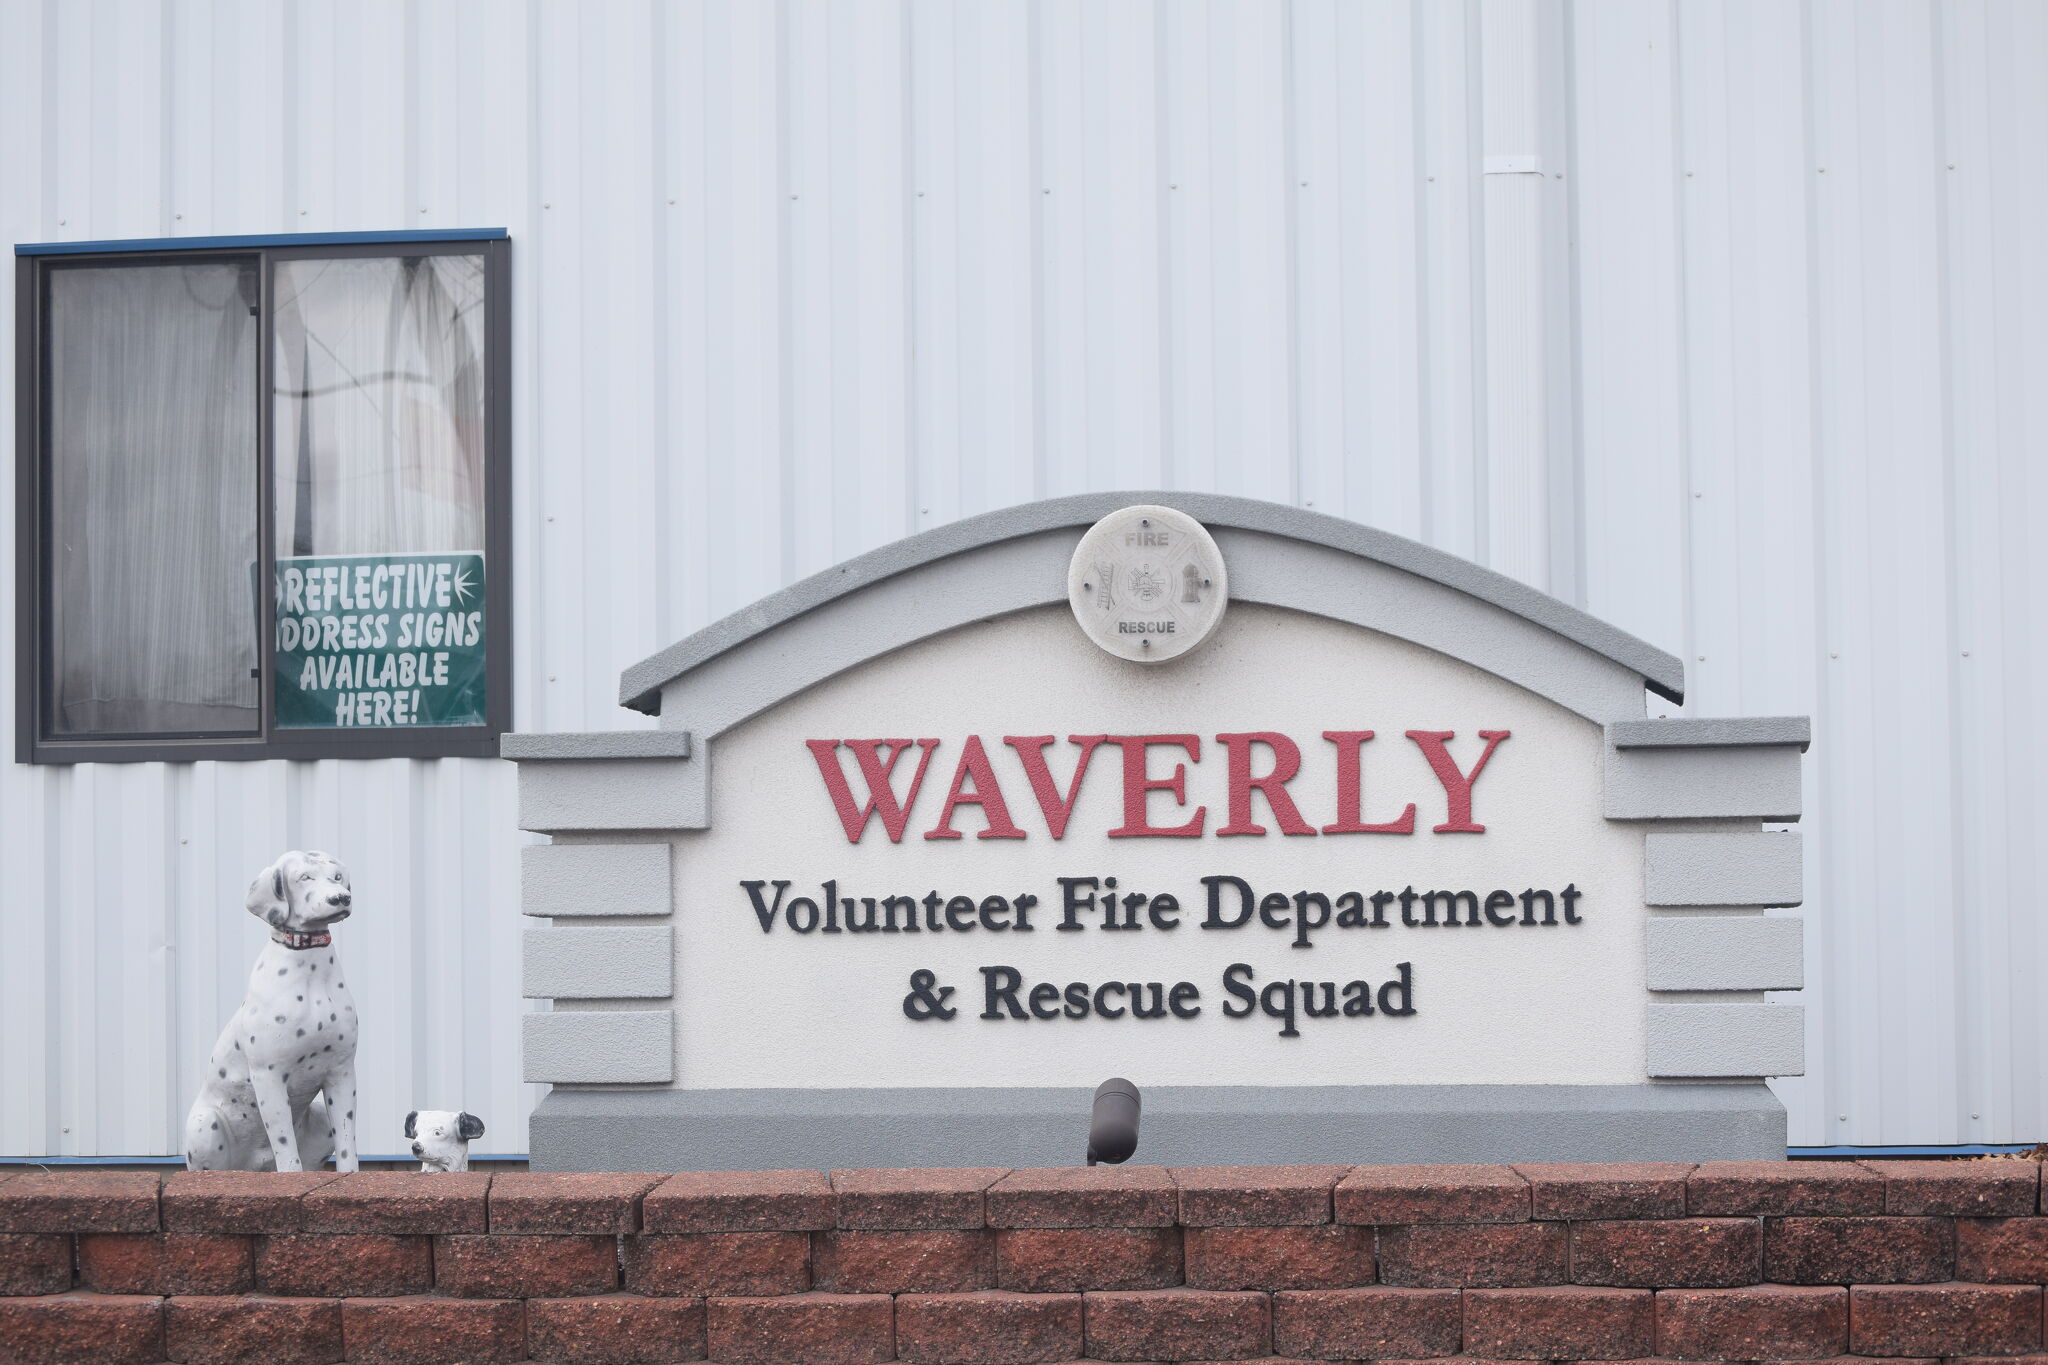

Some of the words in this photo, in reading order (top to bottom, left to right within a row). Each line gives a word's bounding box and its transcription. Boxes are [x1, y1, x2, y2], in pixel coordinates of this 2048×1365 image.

[1125, 532, 1169, 547] FIRE
[284, 563, 451, 615] REFLECTIVE
[276, 614, 390, 652] DDRESS
[397, 611, 482, 648] SIGNS
[1118, 621, 1175, 634] RESCUE
[300, 652, 450, 691] AVAILABLE
[336, 690, 420, 727] HERE!
[806, 730, 1511, 843] WAVERLY
[739, 879, 1038, 934] Volunteer
[1056, 876, 1180, 932] Fire
[1200, 875, 1582, 948] Department
[903, 969, 957, 1020] &
[979, 966, 1201, 1022] Rescue
[1222, 961, 1417, 1037] Squad
